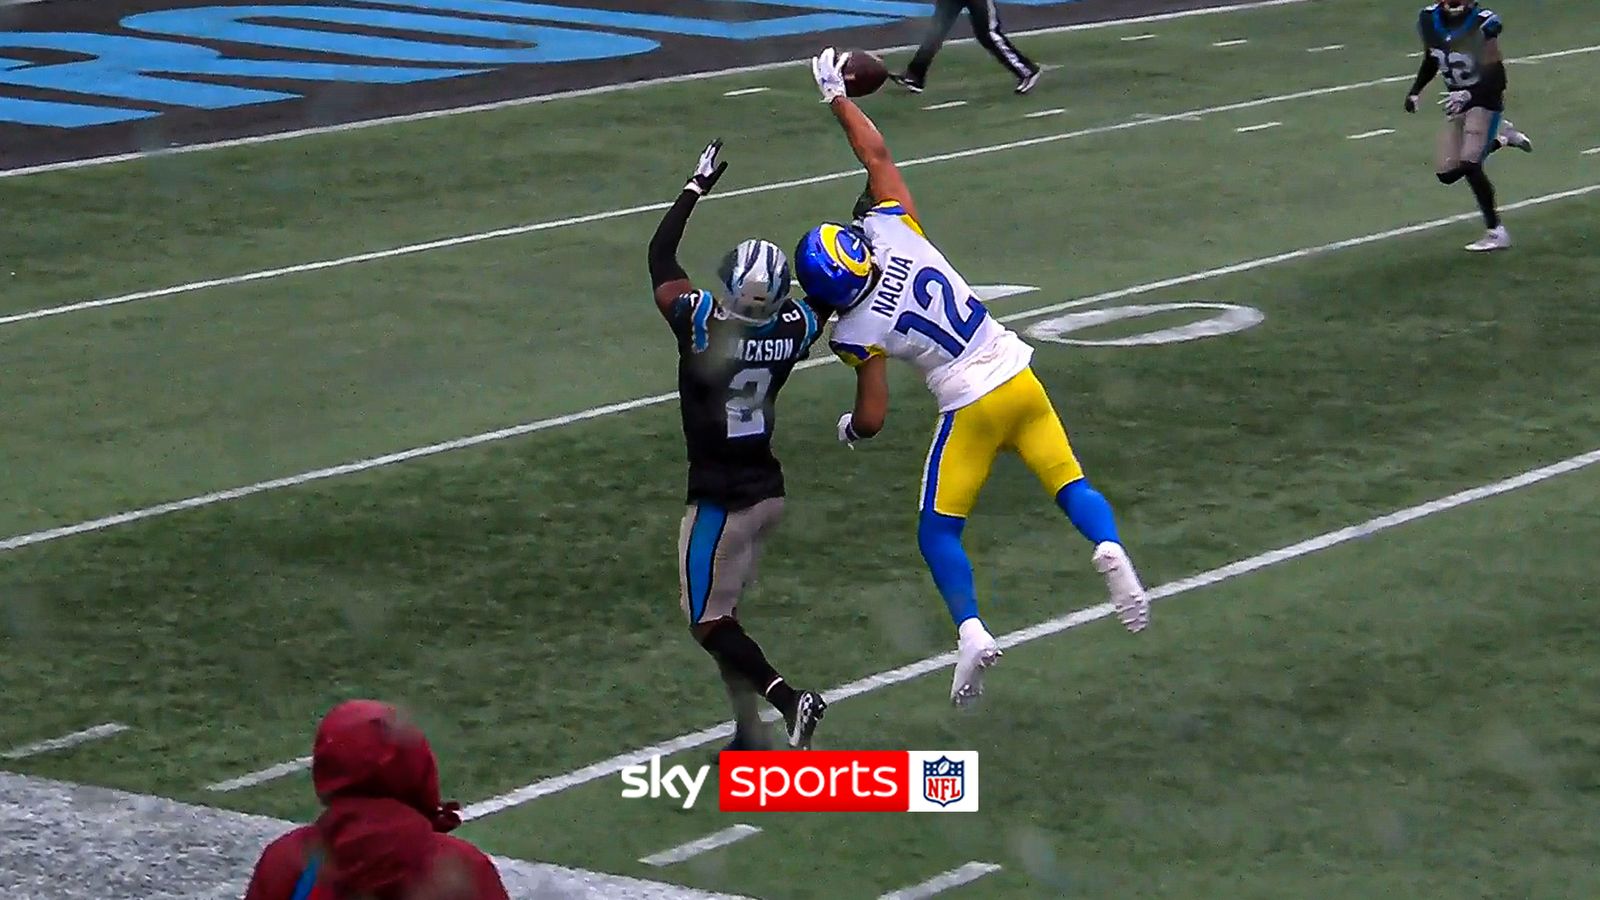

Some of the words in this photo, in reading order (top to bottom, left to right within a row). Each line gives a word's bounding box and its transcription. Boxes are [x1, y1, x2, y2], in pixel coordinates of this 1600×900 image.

[871, 256, 913, 318] NACUA
[894, 266, 988, 359] 12
[728, 338, 794, 361] ACKSON
[725, 368, 773, 437] 2
